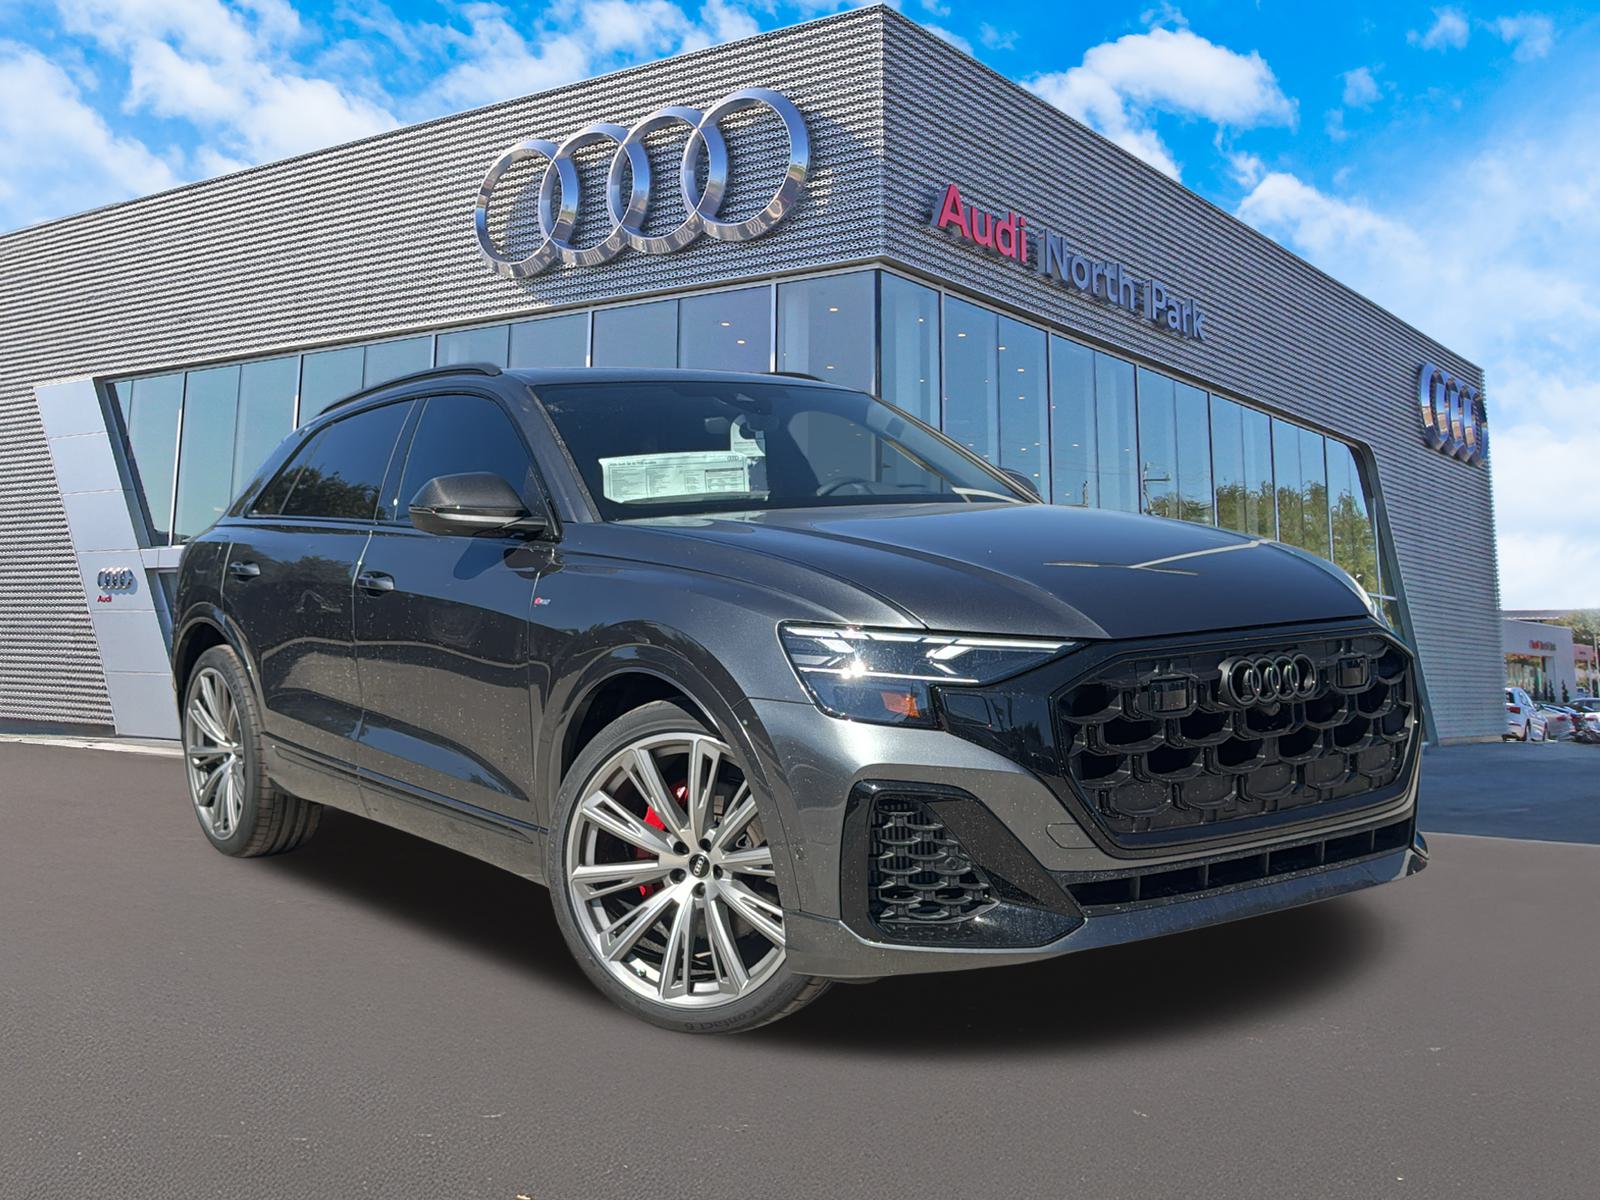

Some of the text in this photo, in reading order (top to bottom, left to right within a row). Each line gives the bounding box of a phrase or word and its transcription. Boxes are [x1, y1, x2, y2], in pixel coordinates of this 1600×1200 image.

[934, 183, 1207, 341] Audi North Park
